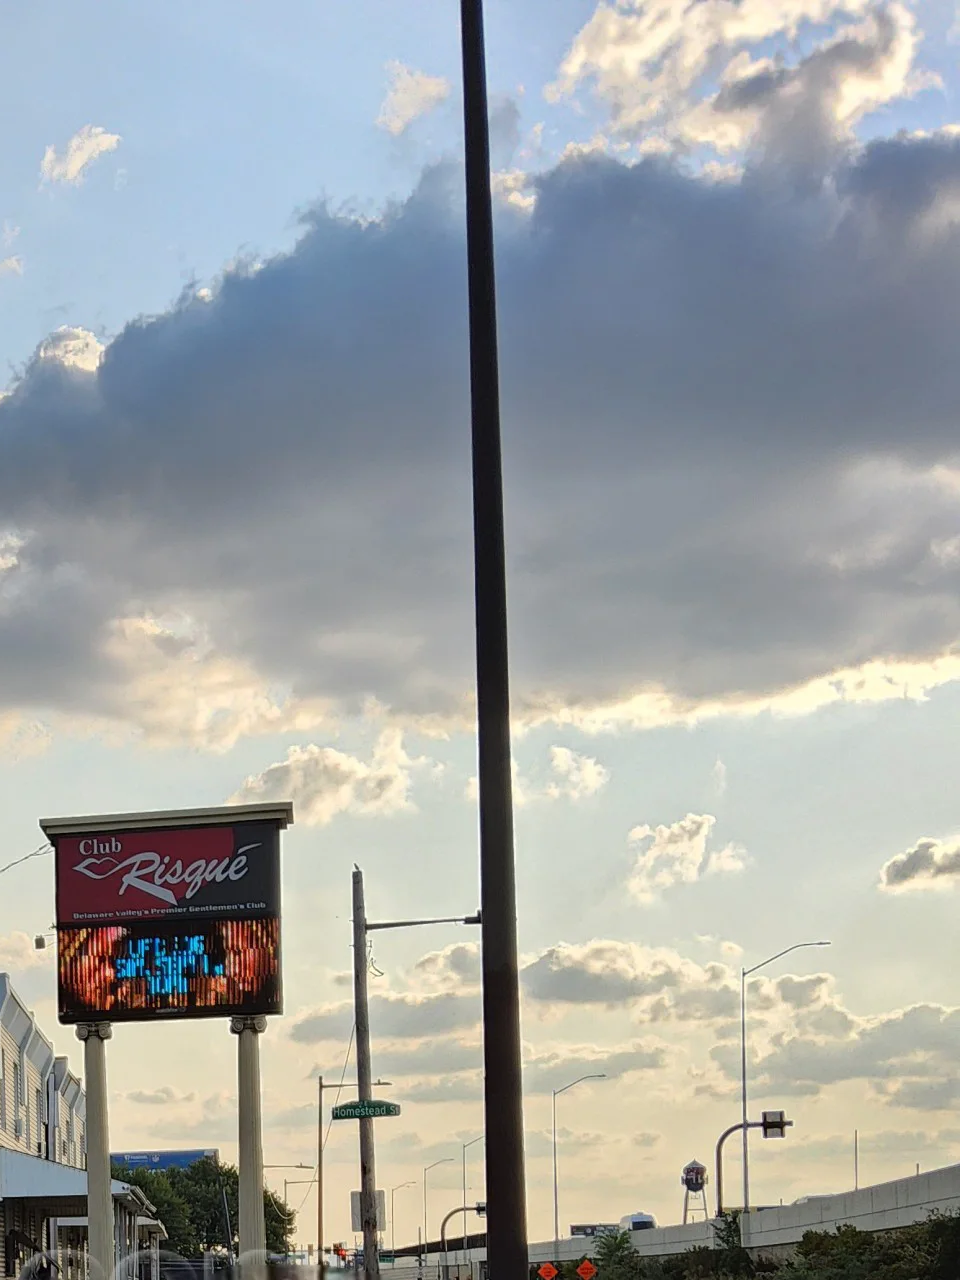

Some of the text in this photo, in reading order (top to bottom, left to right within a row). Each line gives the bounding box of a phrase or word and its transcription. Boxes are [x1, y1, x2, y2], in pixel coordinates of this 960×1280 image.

[79, 837, 122, 855] Club
[119, 843, 262, 906] Risqué
[73, 901, 267, 920] Delaware Valley's Premier Gentlemen's Club
[334, 1105, 400, 1117] Homestead St
